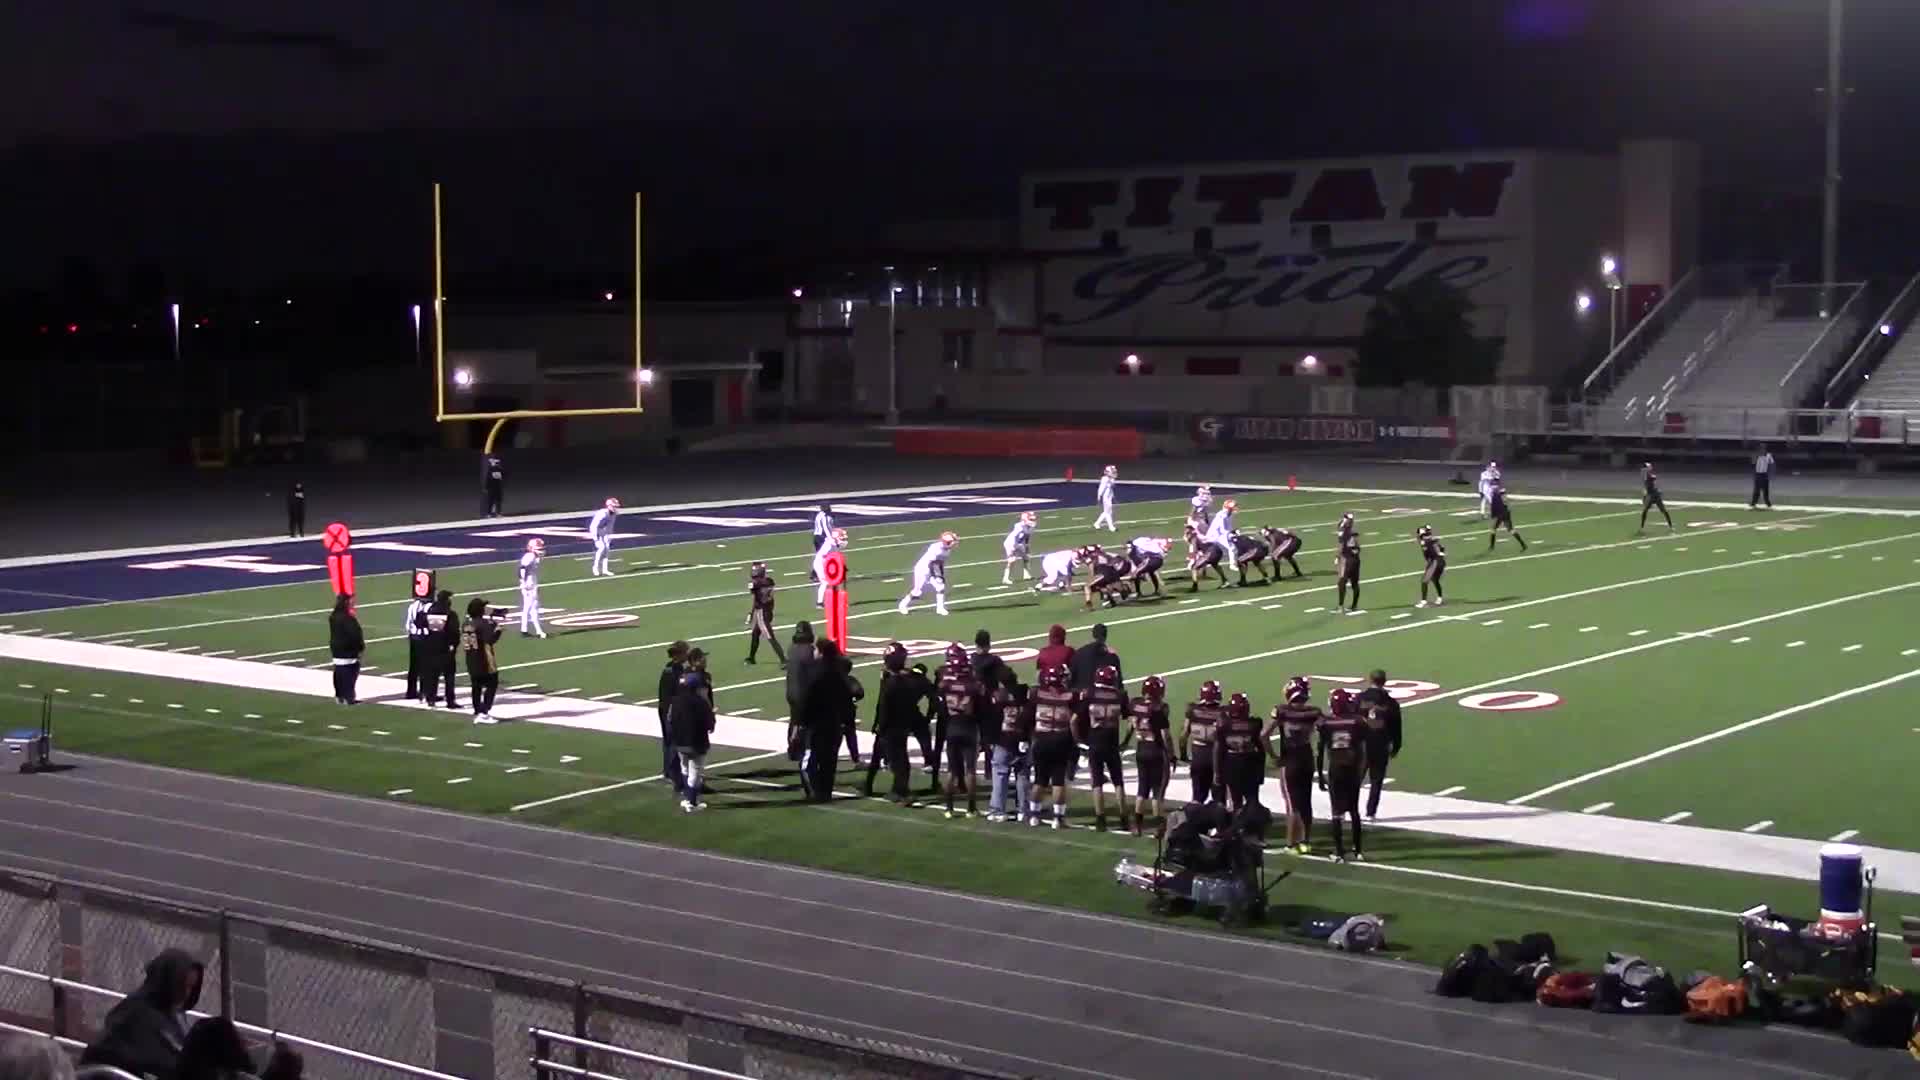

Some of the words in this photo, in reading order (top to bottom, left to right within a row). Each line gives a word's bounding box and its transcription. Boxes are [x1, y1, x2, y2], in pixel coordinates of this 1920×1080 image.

[1034, 161, 1515, 229] TITAN
[1044, 241, 1512, 325] Pride
[415, 572, 430, 597] 3
